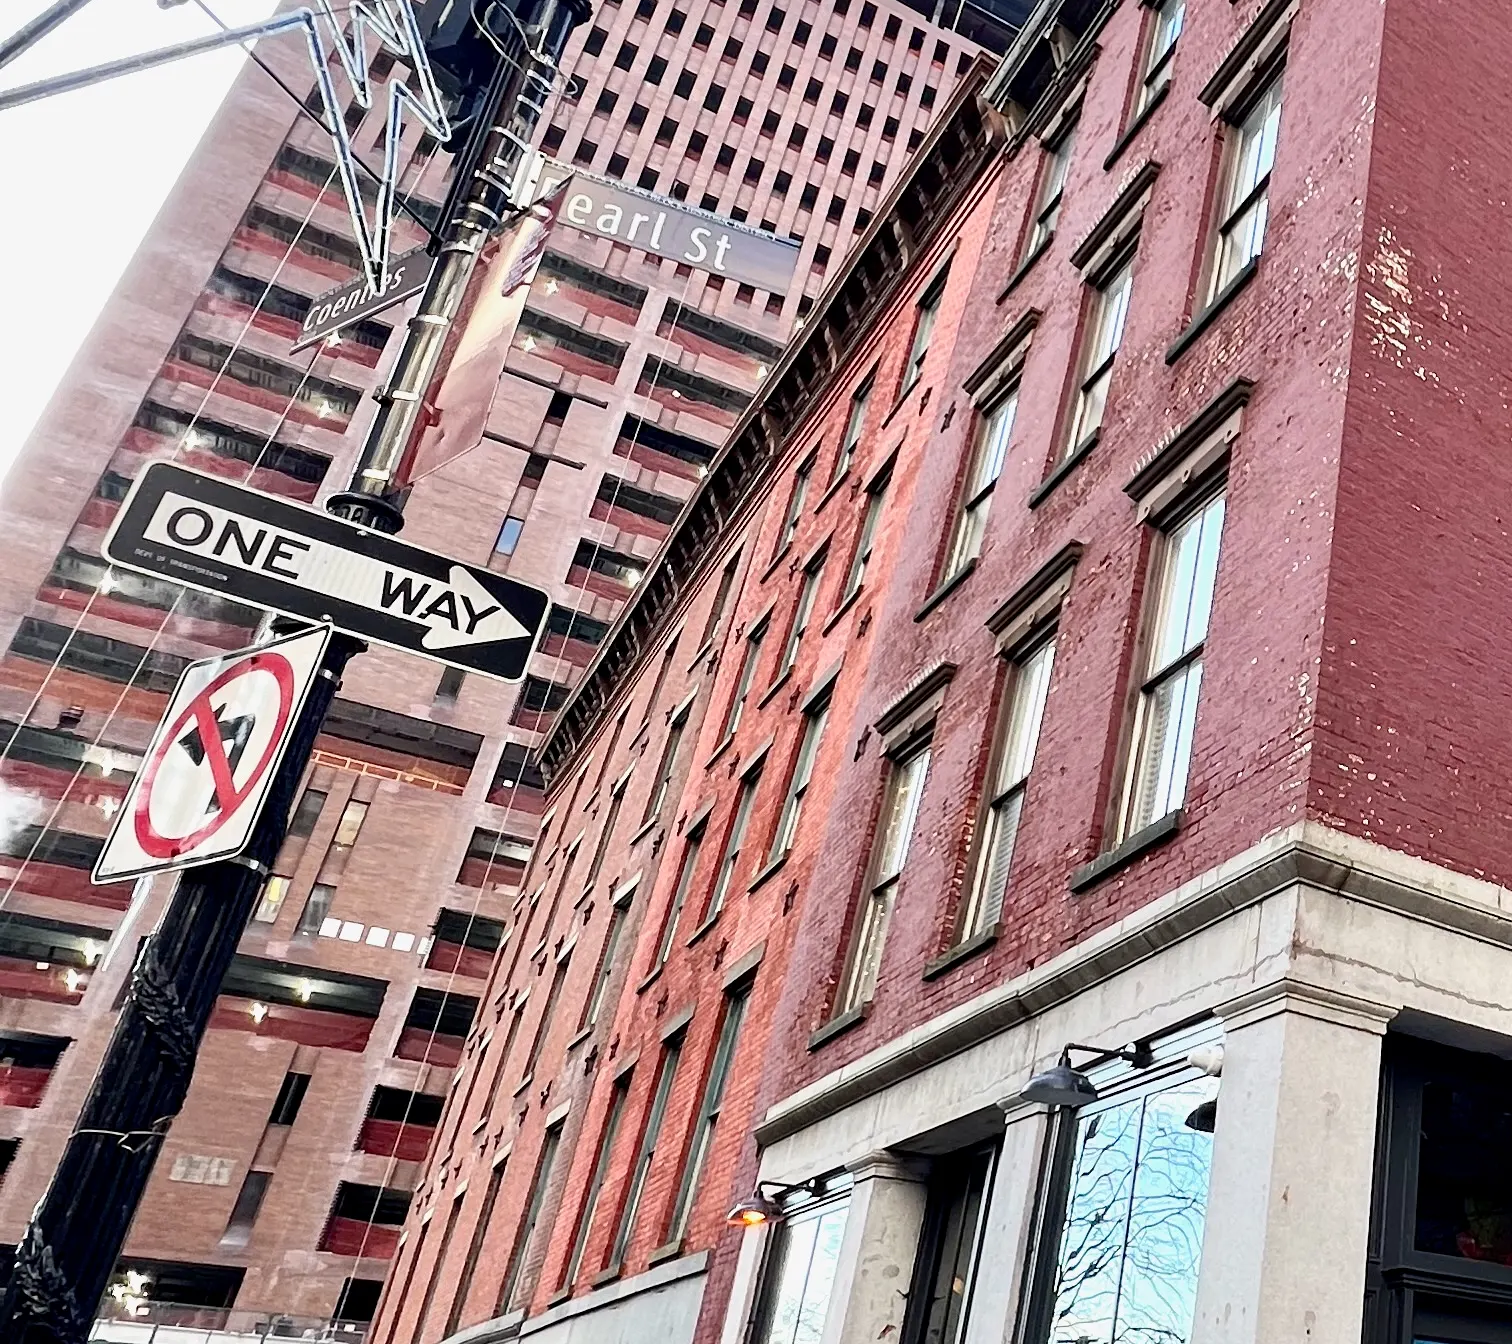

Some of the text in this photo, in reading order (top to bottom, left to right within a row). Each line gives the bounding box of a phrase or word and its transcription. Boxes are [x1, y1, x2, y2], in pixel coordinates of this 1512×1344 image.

[684, 227, 732, 270] St
[303, 266, 406, 332] Coents
[166, 507, 501, 635] ONE WAY
